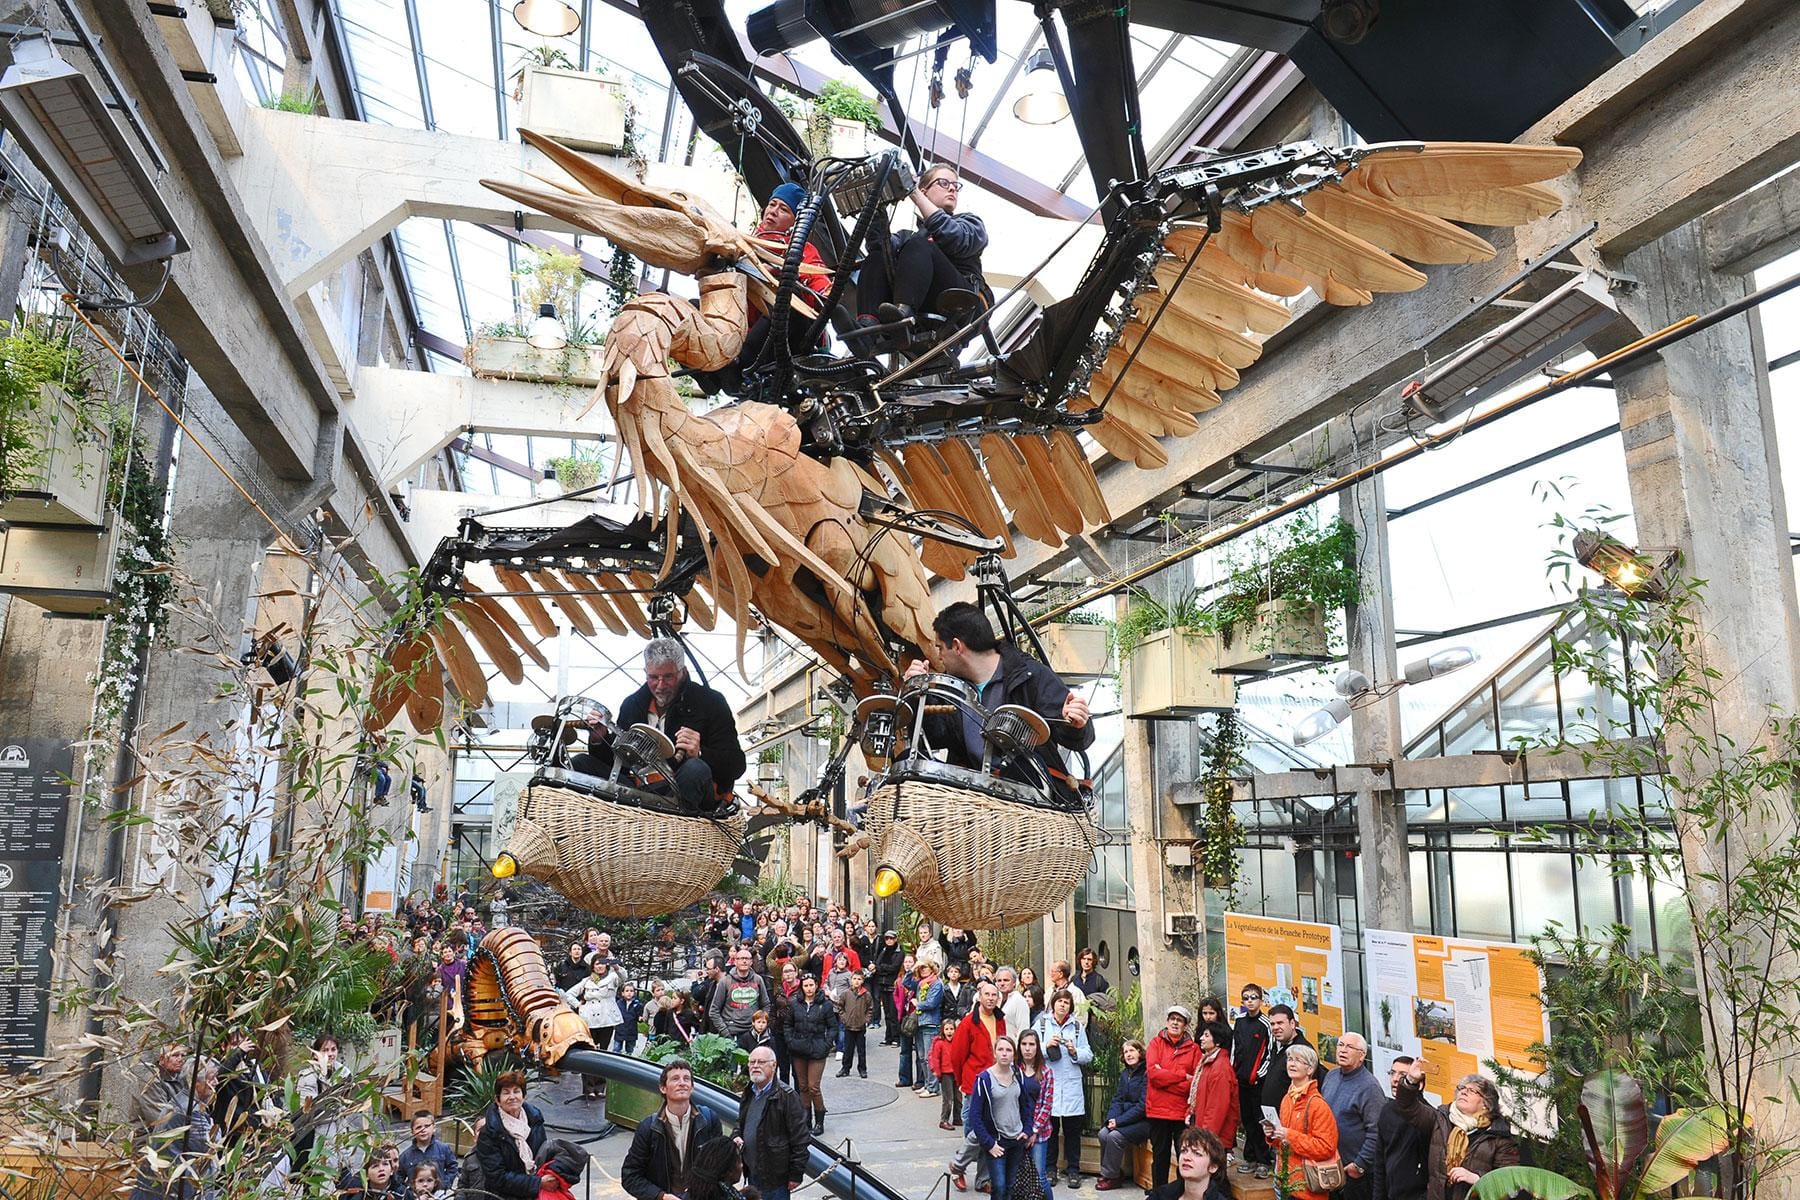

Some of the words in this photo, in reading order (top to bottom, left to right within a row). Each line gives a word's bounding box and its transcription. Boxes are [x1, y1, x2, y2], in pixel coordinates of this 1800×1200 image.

[1267, 925, 1273, 934] de
[1280, 927, 1301, 938] Branche
[1303, 930, 1330, 943] Prototype
